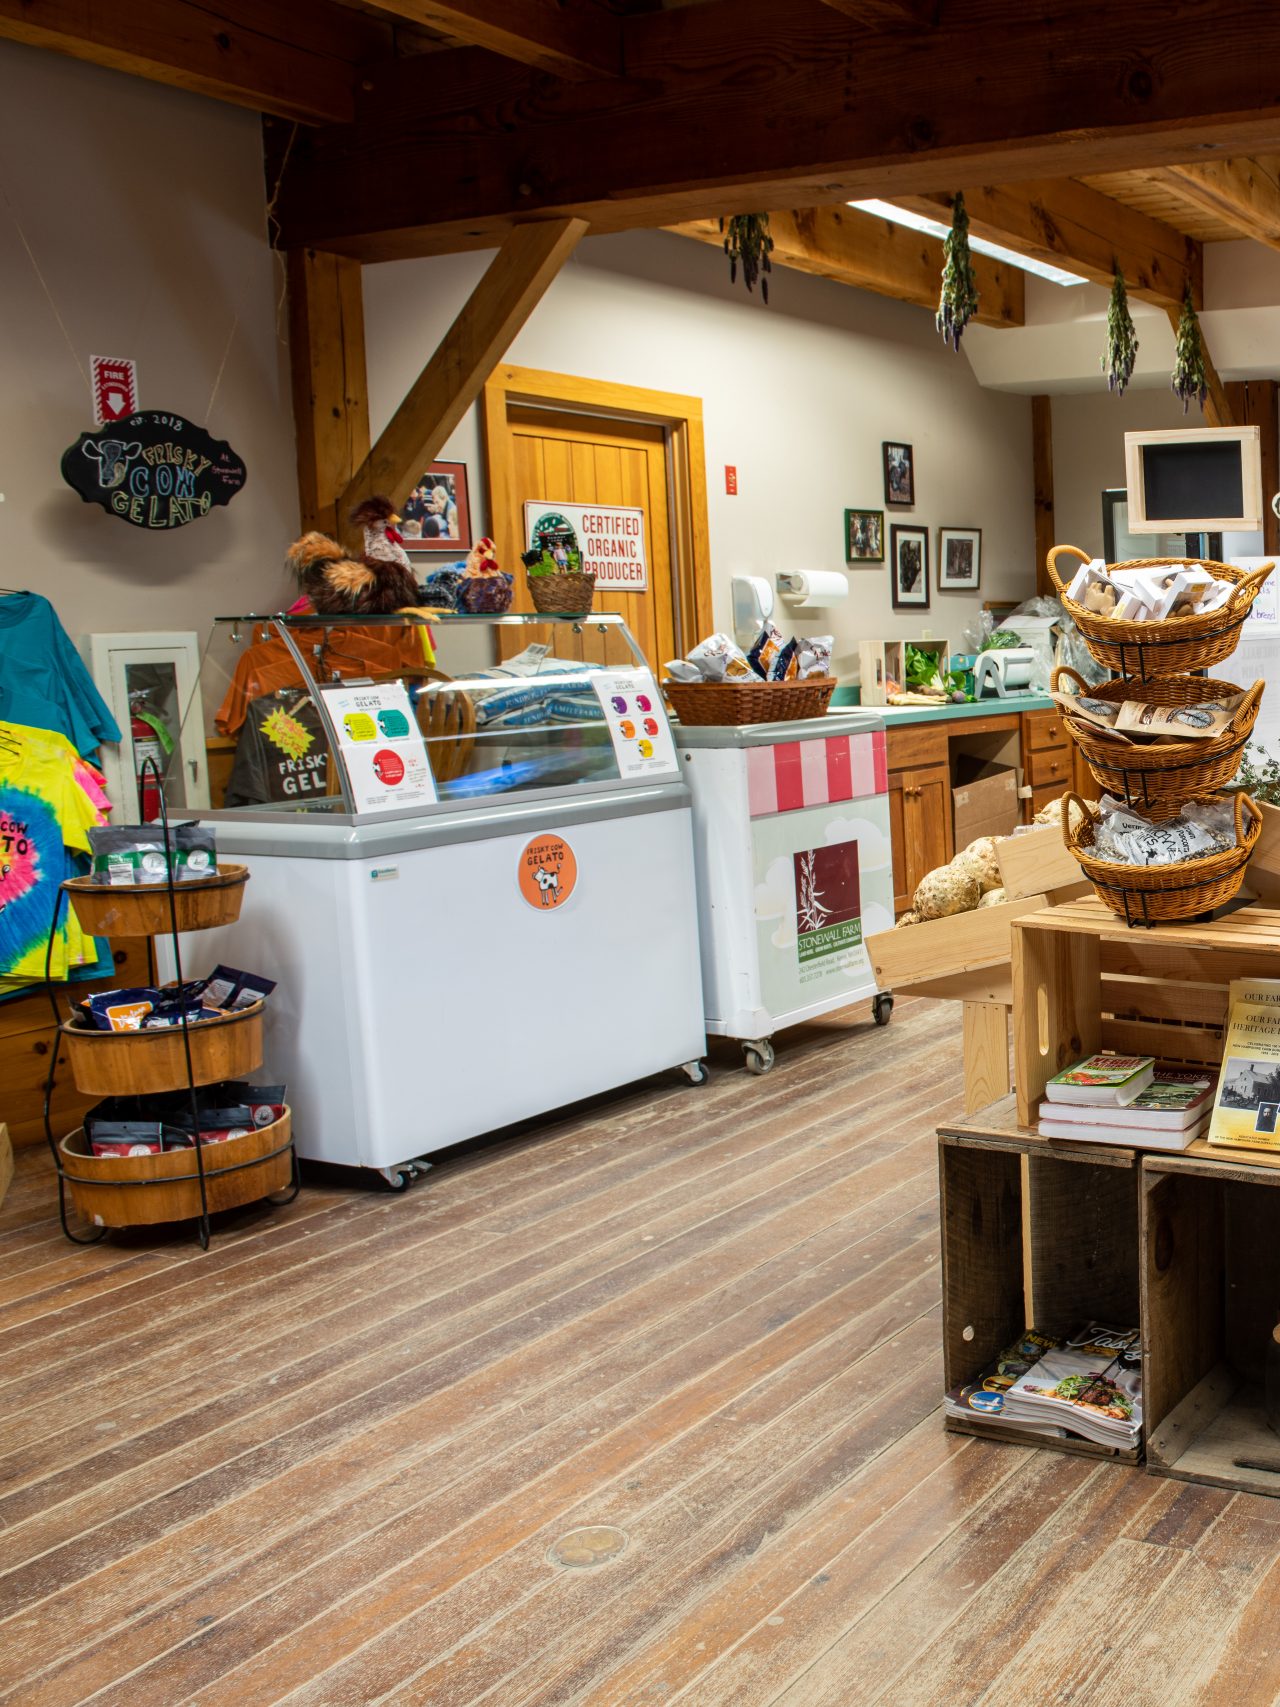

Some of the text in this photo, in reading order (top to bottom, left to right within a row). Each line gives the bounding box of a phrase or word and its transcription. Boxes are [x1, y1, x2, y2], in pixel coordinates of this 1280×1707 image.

[104, 370, 125, 381] FIRE
[152, 414, 183, 432] 2018
[142, 442, 213, 477] FRISKY
[129, 464, 196, 498] COW
[111, 490, 212, 527] GELATO
[582, 514, 640, 536] CERTIFIED
[587, 538, 637, 558] ORGANIC
[584, 561, 643, 581] PRODUCER
[355, 700, 382, 708] GELATO
[282, 771, 327, 795] GEL
[0, 820, 29, 834] COW
[1, 835, 28, 855] TO
[527, 843, 564, 855] FRISKY COW
[527, 852, 564, 866] GELATO
[799, 922, 861, 951] STONEWALL FARM
[1244, 993, 1264, 1001] OUR
[1232, 1022, 1276, 1034] HERITAGE
[1246, 1015, 1266, 1023] OUR
